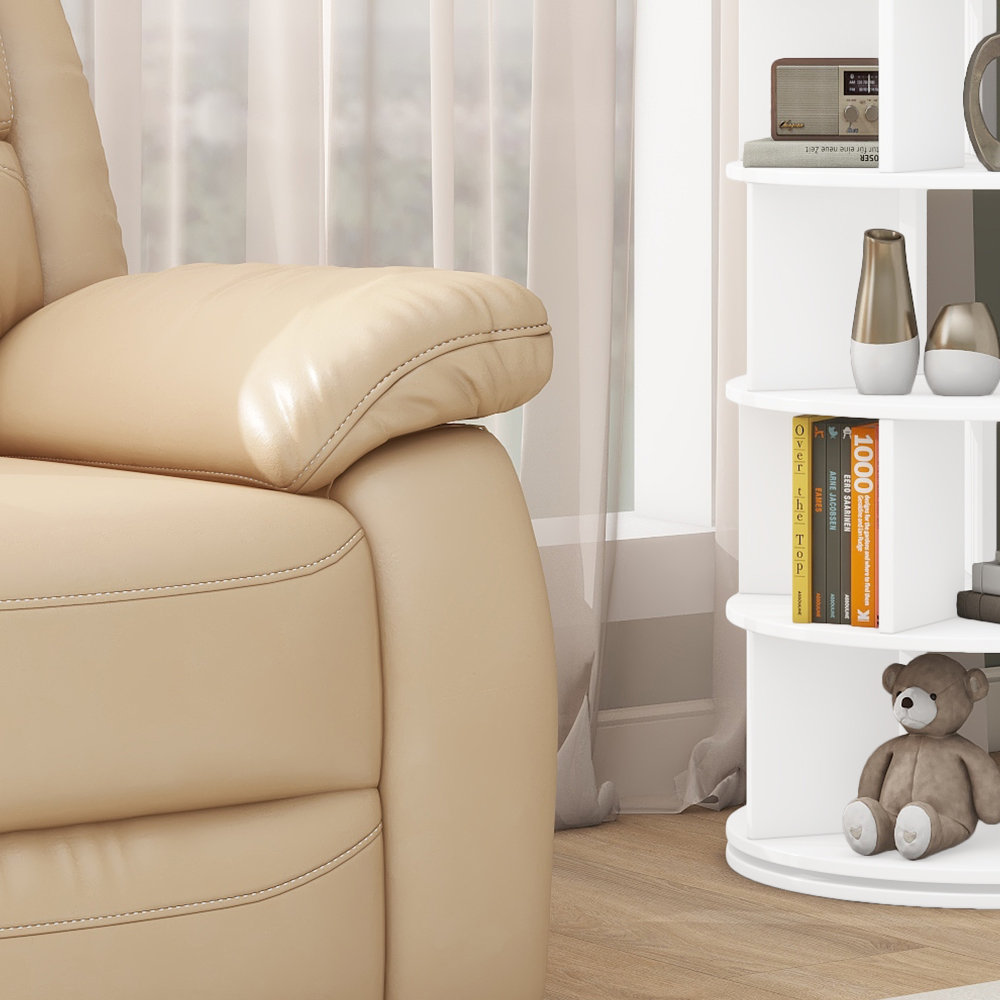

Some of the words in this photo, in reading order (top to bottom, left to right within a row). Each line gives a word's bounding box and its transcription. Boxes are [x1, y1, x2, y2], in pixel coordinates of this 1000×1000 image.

[840, 146, 855, 154] eine
[794, 424, 805, 472] Over
[854, 434, 874, 494] 1000
[795, 486, 804, 522] the
[794, 533, 805, 576] Top
